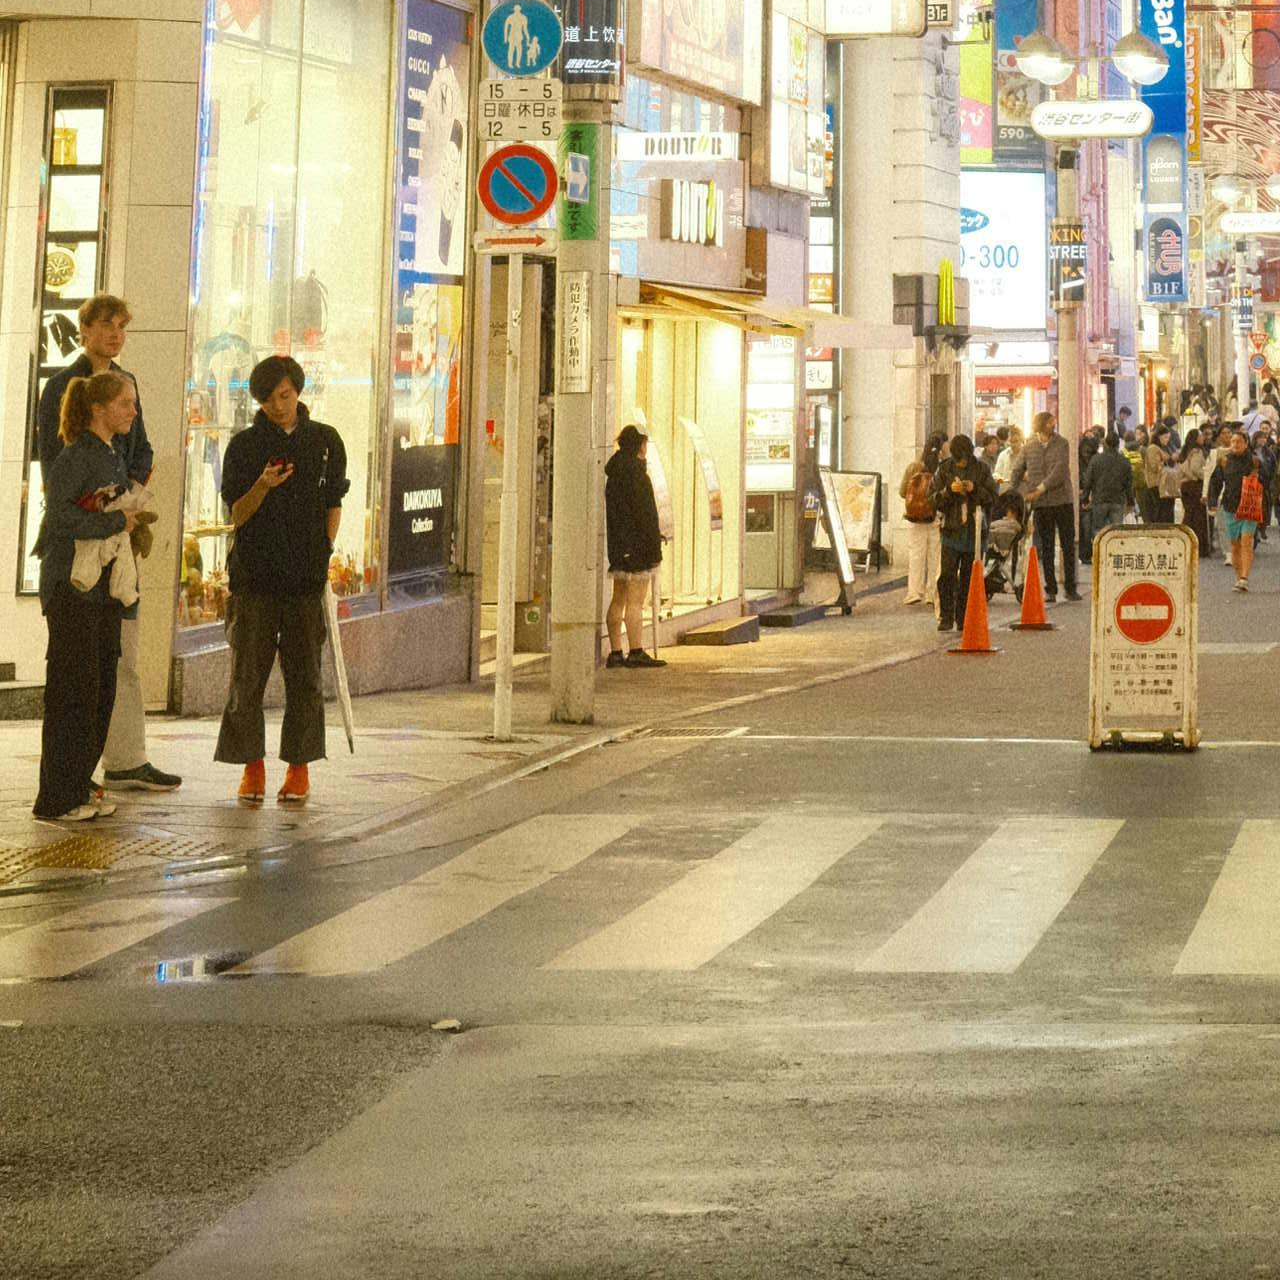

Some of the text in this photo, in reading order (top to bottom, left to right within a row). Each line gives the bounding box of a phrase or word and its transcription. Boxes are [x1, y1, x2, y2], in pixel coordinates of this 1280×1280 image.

[408, 57, 430, 76] GUCCI
[489, 84, 504, 99] 15
[543, 84, 552, 99] 5
[488, 122, 503, 137] 12
[542, 121, 551, 136] 5
[1000, 128, 1024, 140] 590
[403, 488, 443, 511] DAIKOKUYA
[1112, 553, 1178, 571] 車両進入禁止
